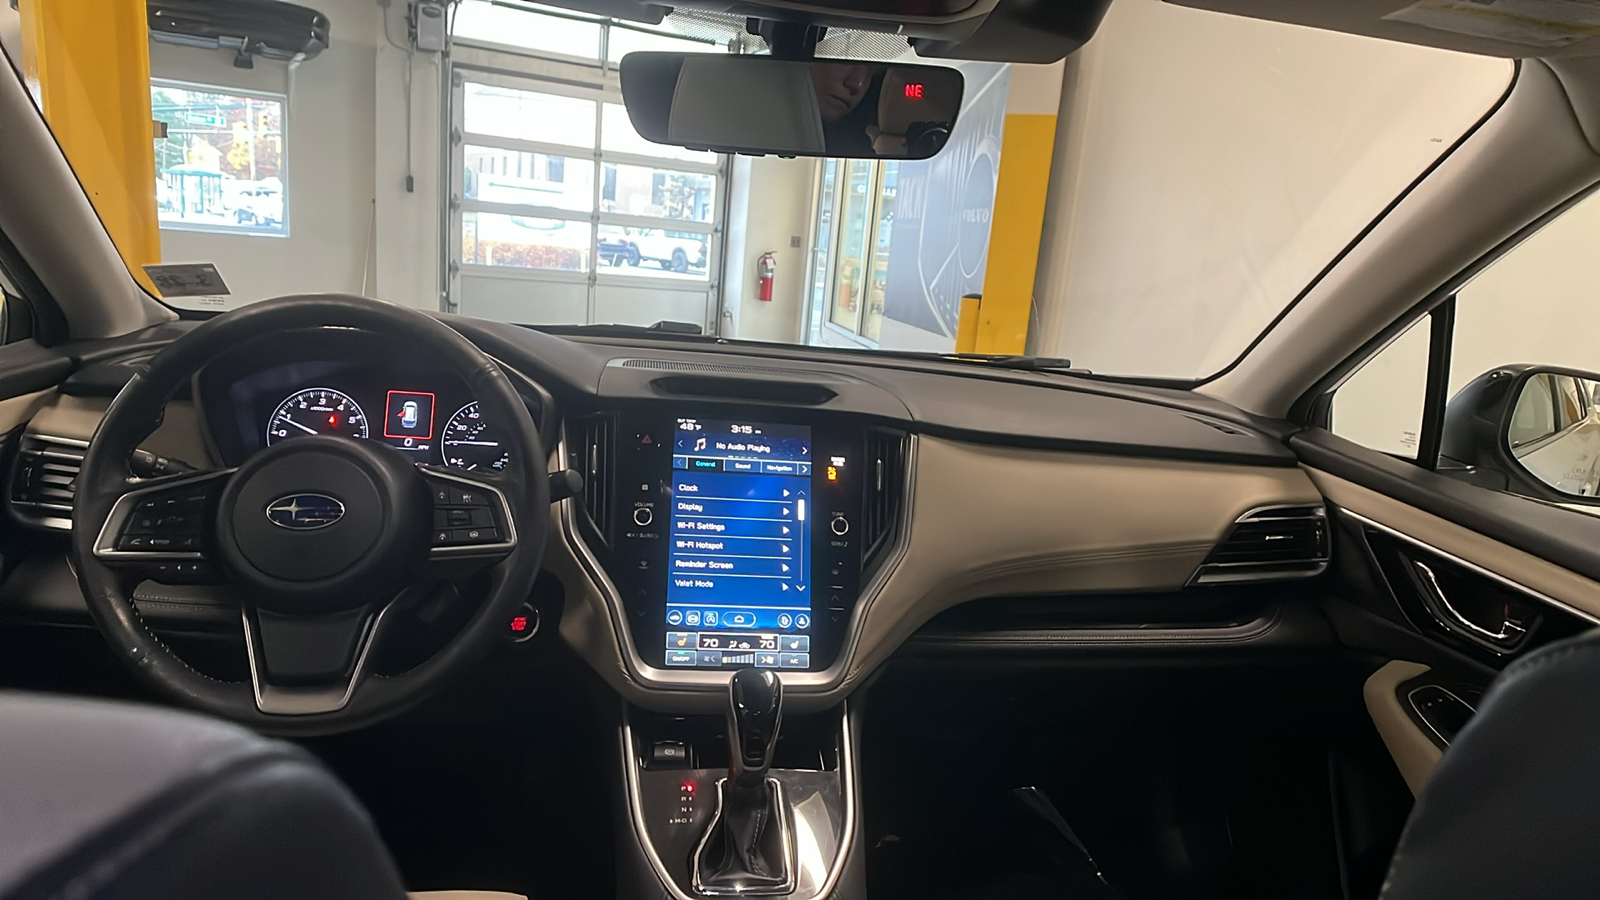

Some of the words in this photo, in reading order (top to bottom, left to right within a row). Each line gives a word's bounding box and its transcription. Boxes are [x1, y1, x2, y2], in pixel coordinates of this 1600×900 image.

[905, 84, 923, 98] NE
[348, 416, 356, 424] 5
[679, 423, 694, 431] 48
[730, 425, 753, 434] 3:15
[278, 429, 287, 437] 0
[403, 438, 413, 447] 0
[716, 442, 727, 450] No
[727, 443, 746, 451] Audio
[747, 444, 771, 453] Playing
[695, 460, 716, 468] General
[735, 462, 751, 470] Sound
[767, 464, 793, 472] Navigation
[678, 484, 698, 492] Clock
[677, 502, 703, 512] Display
[677, 521, 695, 530] Wi-Fi
[696, 522, 725, 532] Settings
[676, 540, 695, 548] Wi-Fi
[696, 541, 724, 551] Hotspot
[675, 559, 707, 569] Reminder
[708, 561, 734, 570] Screen
[674, 579, 694, 588] Valet
[695, 580, 714, 588] Mode
[702, 638, 719, 647] 70
[759, 640, 775, 649] 70
